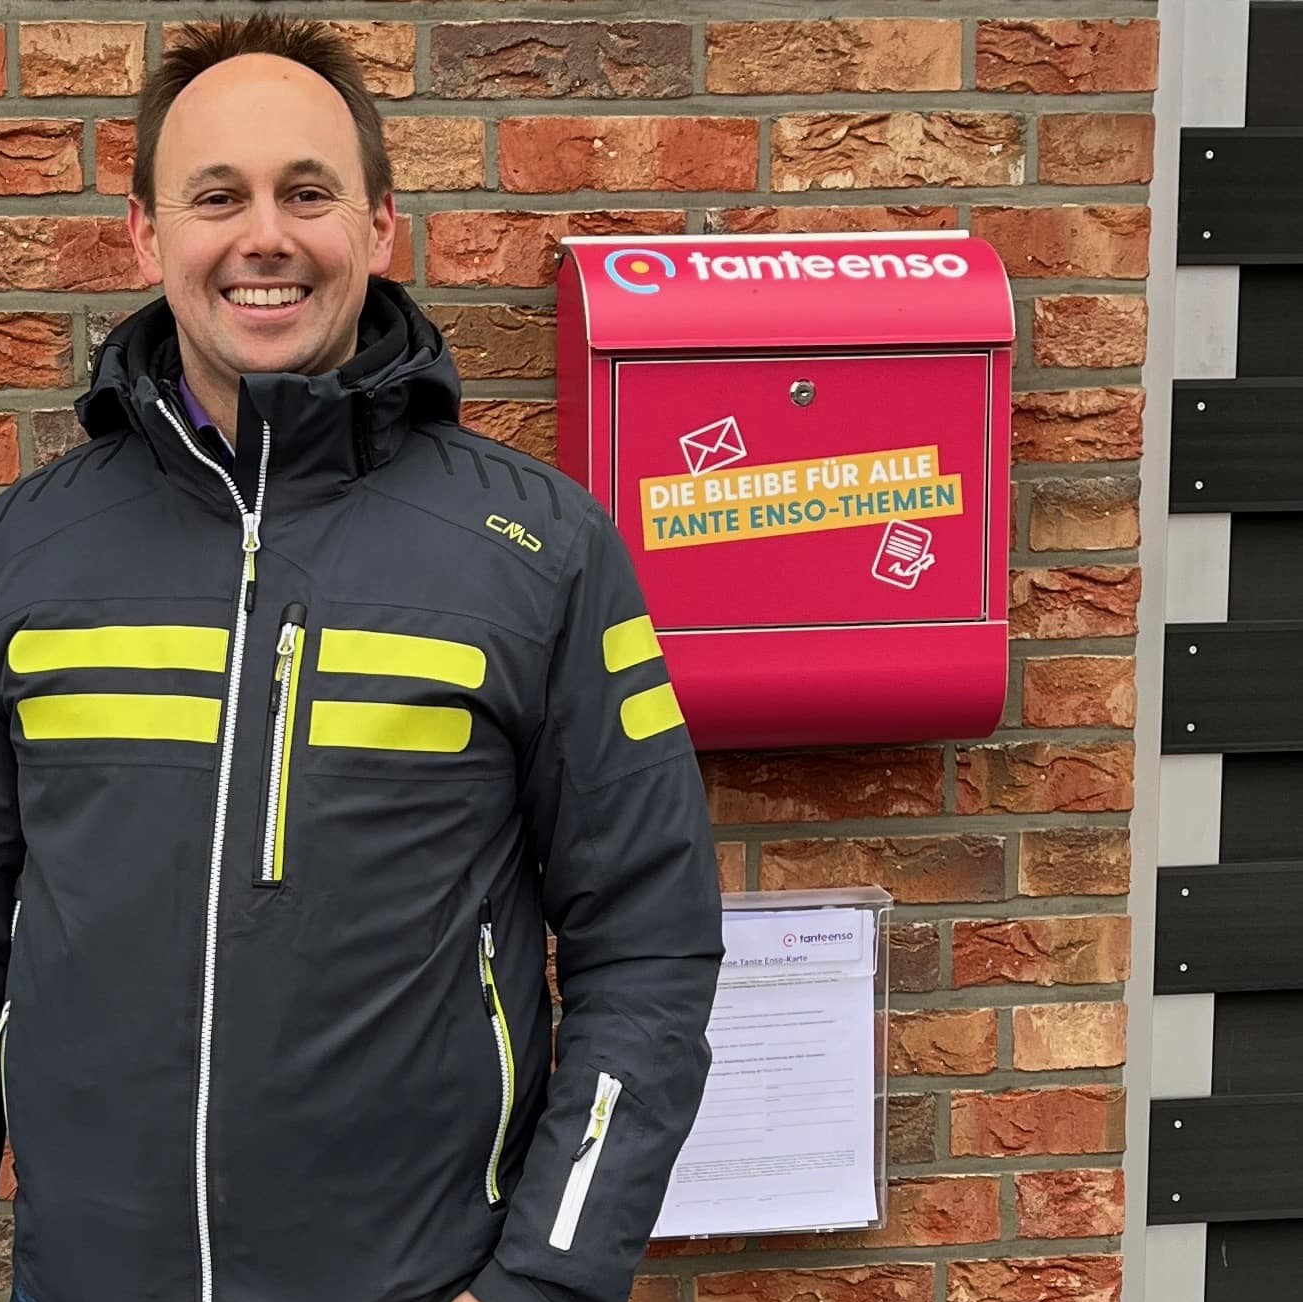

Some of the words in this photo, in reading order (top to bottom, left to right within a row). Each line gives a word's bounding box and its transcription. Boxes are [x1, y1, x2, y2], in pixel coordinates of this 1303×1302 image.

[687, 251, 968, 280] tanteenso
[650, 482, 696, 510] DIE
[705, 469, 797, 503] BLEIBE
[806, 458, 859, 491] FÜR
[869, 454, 932, 484] ALLE
[652, 508, 740, 540] TANTE
[750, 484, 955, 529] ENSO-THEMEN
[486, 514, 542, 552] CMP
[799, 932, 854, 944] tanteenso
